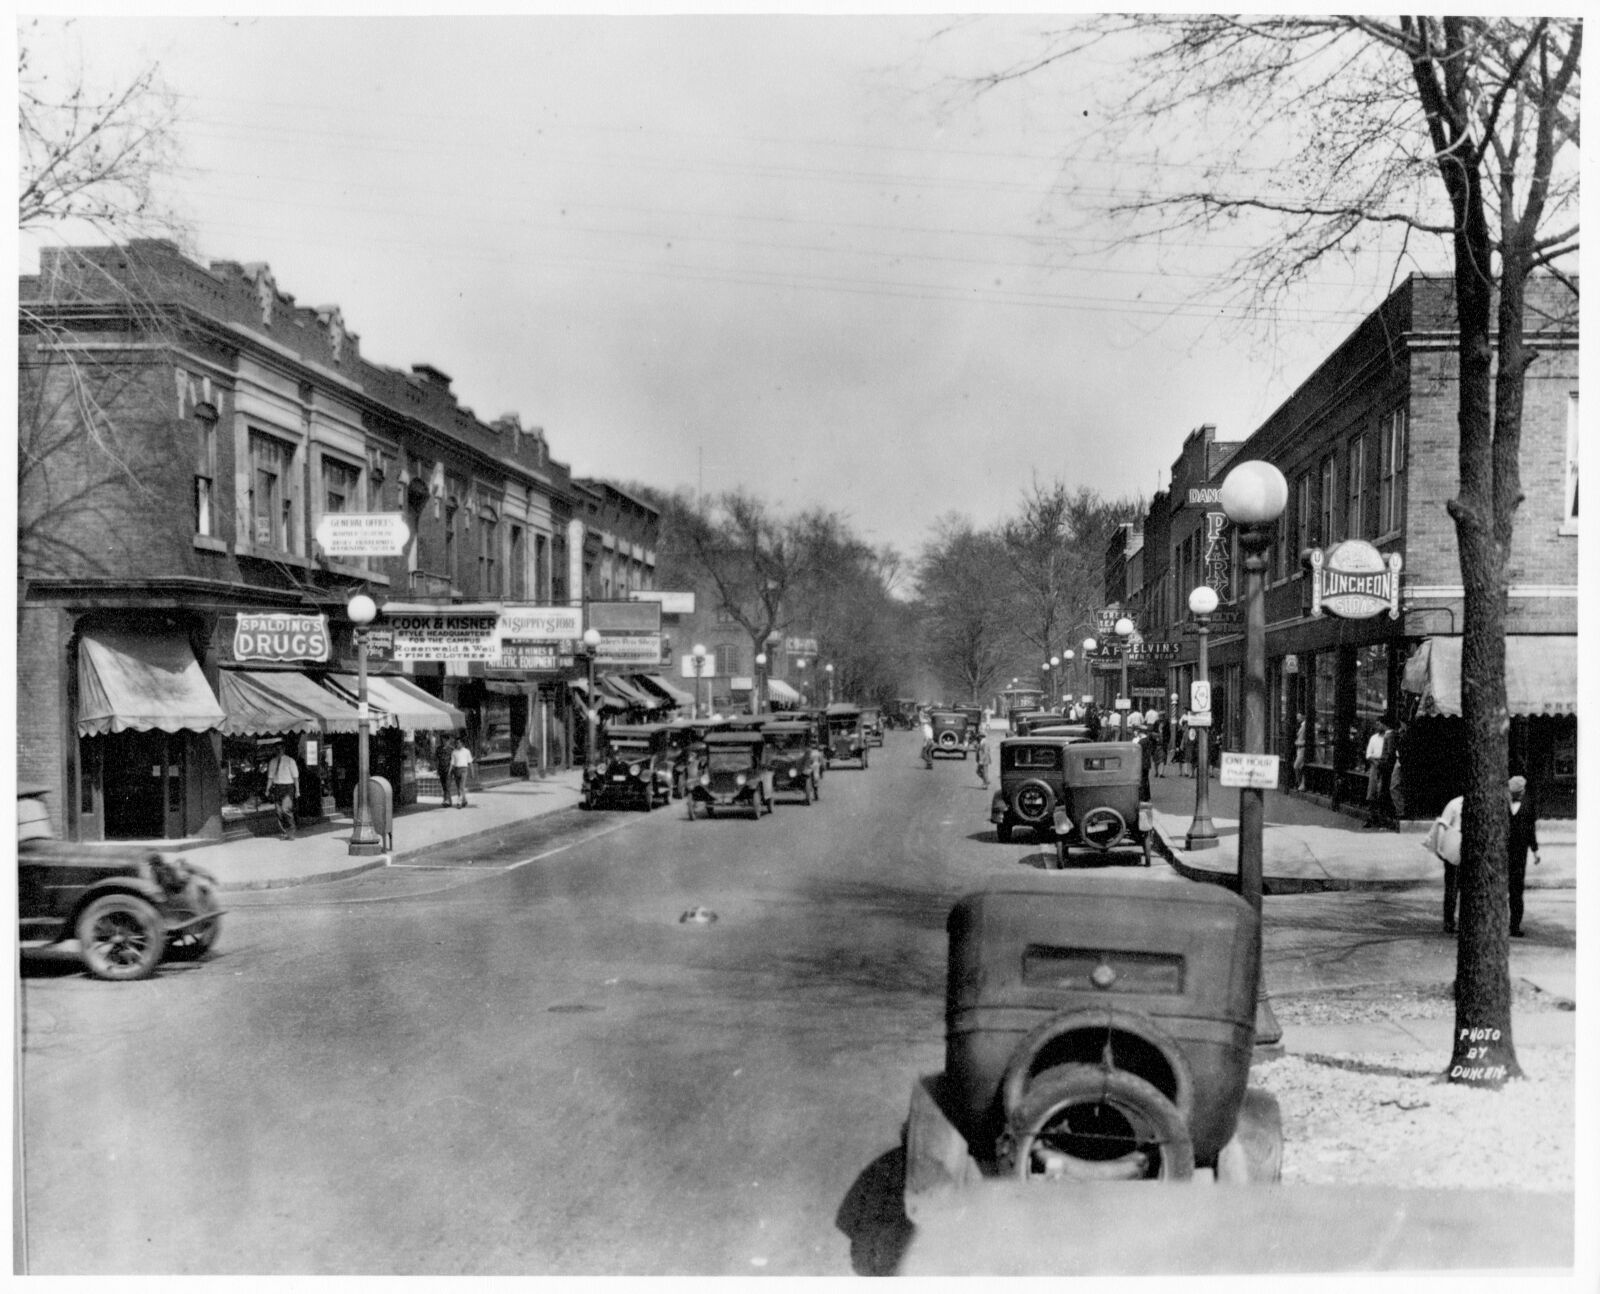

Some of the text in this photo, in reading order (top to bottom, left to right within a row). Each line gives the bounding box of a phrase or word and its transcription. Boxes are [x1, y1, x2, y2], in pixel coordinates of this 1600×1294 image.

[1205, 512, 1229, 604] PARK
[1322, 570, 1391, 600] LUNCHEON
[241, 620, 321, 632] SPALDING'S
[392, 617, 497, 630] COOK & KISNER
[512, 617, 546, 633] SUPPLY
[546, 617, 575, 633] STORE
[240, 634, 324, 655] DRUGS
[394, 644, 459, 652] Rosenwald
[520, 656, 556, 668] EQUIPMENT
[1225, 757, 1243, 765] ONE
